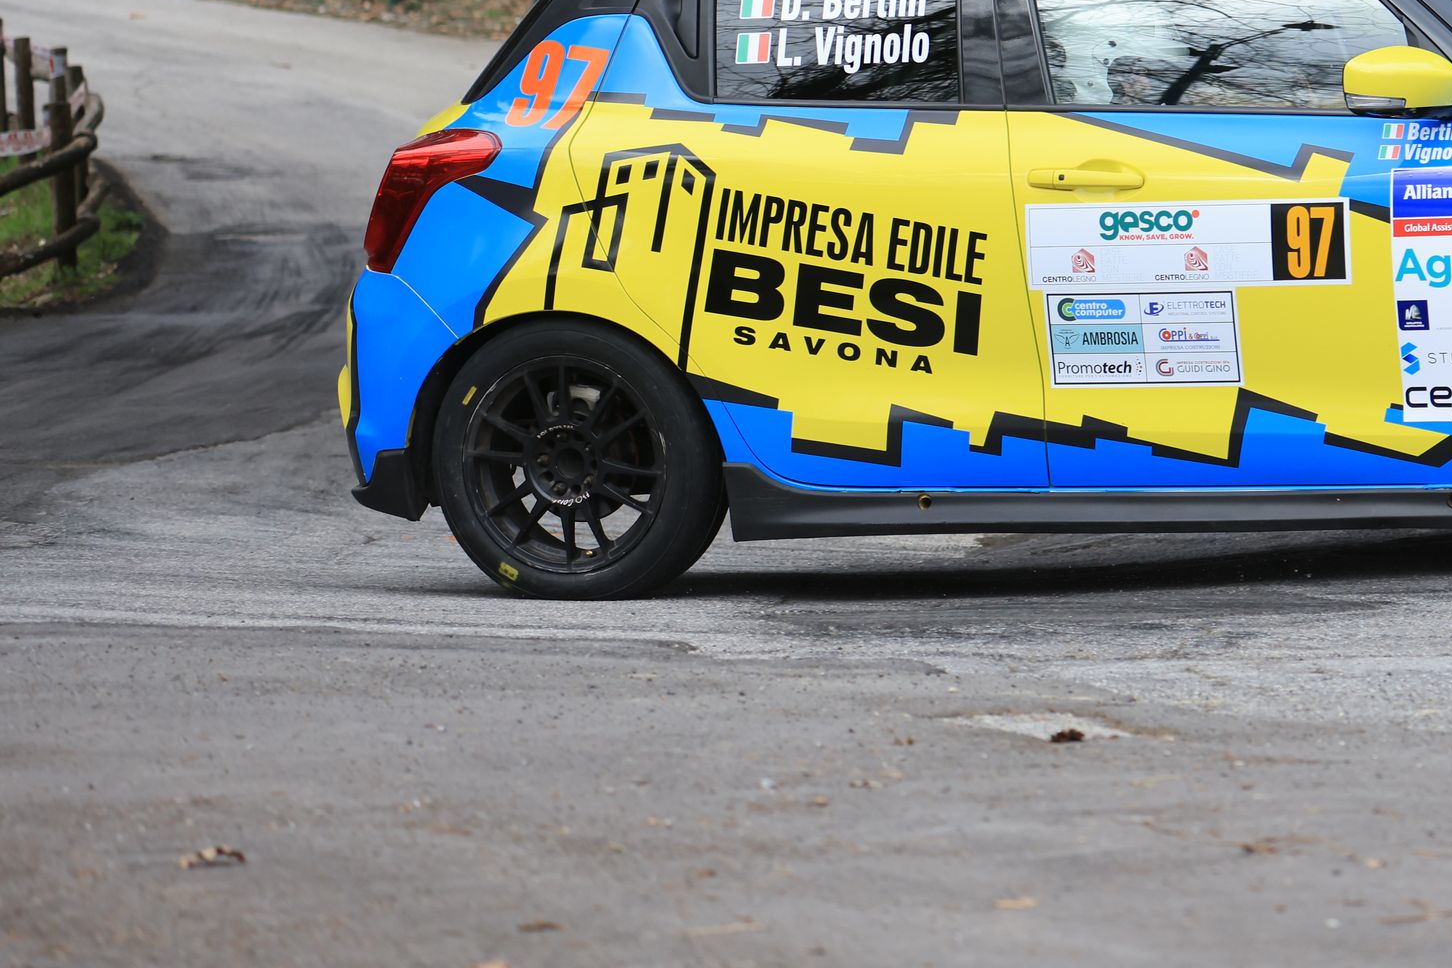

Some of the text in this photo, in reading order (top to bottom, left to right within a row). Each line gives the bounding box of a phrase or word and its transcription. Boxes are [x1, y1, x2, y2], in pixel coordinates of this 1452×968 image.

[777, 23, 930, 74] L. Vignolo
[505, 40, 610, 129] 97
[1099, 210, 1193, 241] gesco
[1404, 223, 1430, 232] Global
[715, 188, 988, 285] IMPRESA EDILE
[1286, 205, 1335, 278] 97
[1042, 275, 1097, 283] CENTROLEGNO
[704, 248, 982, 356] BESI
[1074, 302, 1107, 310] centro
[1167, 300, 1226, 310] ELETTROTECH
[1075, 309, 1123, 318] computer
[1082, 331, 1138, 346] AMBROSIA
[733, 326, 933, 374] SAVONA
[1058, 361, 1132, 375] Promotech
[1177, 364, 1231, 373] GUIDI GINO
